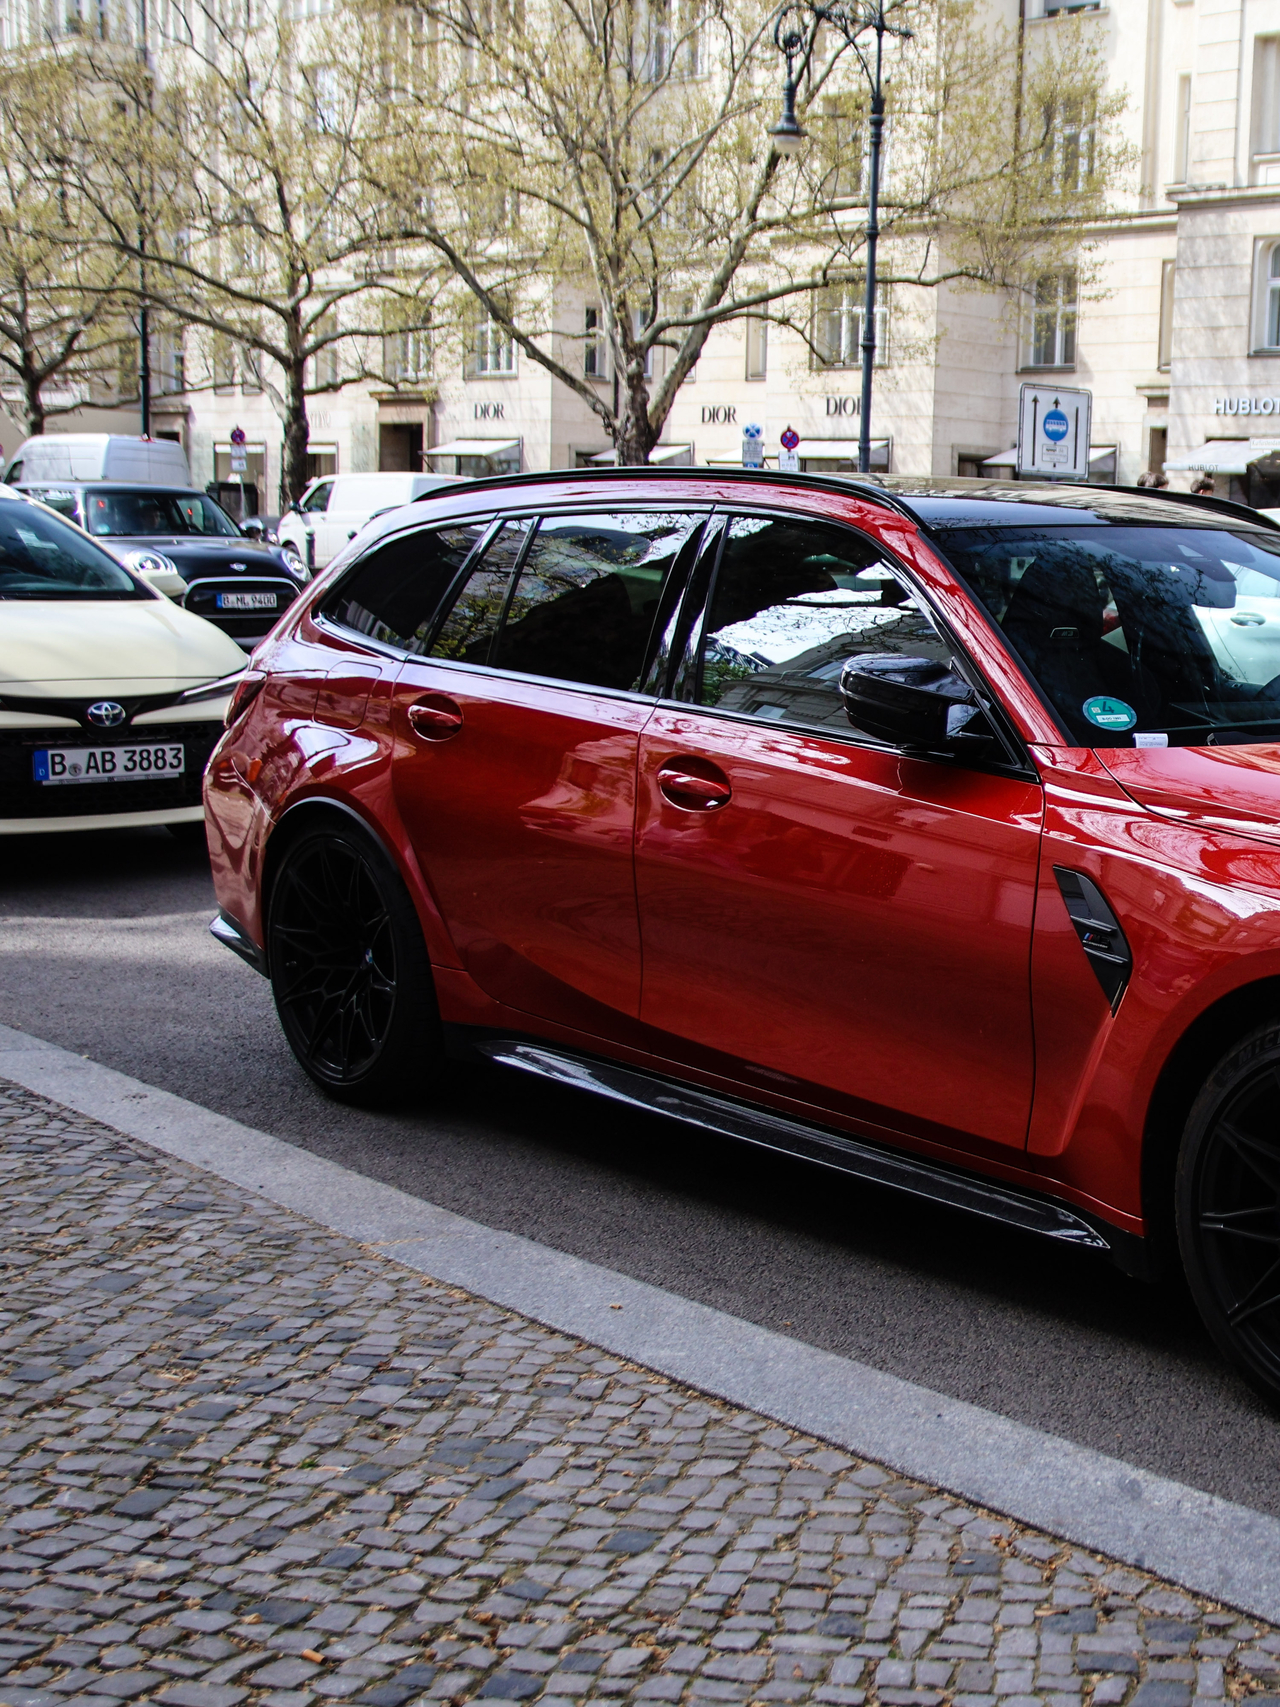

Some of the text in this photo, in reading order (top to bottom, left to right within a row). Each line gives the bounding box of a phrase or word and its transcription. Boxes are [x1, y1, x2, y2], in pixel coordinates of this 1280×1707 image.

[474, 402, 505, 419] DIOR
[701, 406, 737, 424] DIOR
[1188, 464, 1219, 472] HUBLOT
[1102, 701, 1115, 714] 4
[50, 747, 182, 776] B AB 3883
